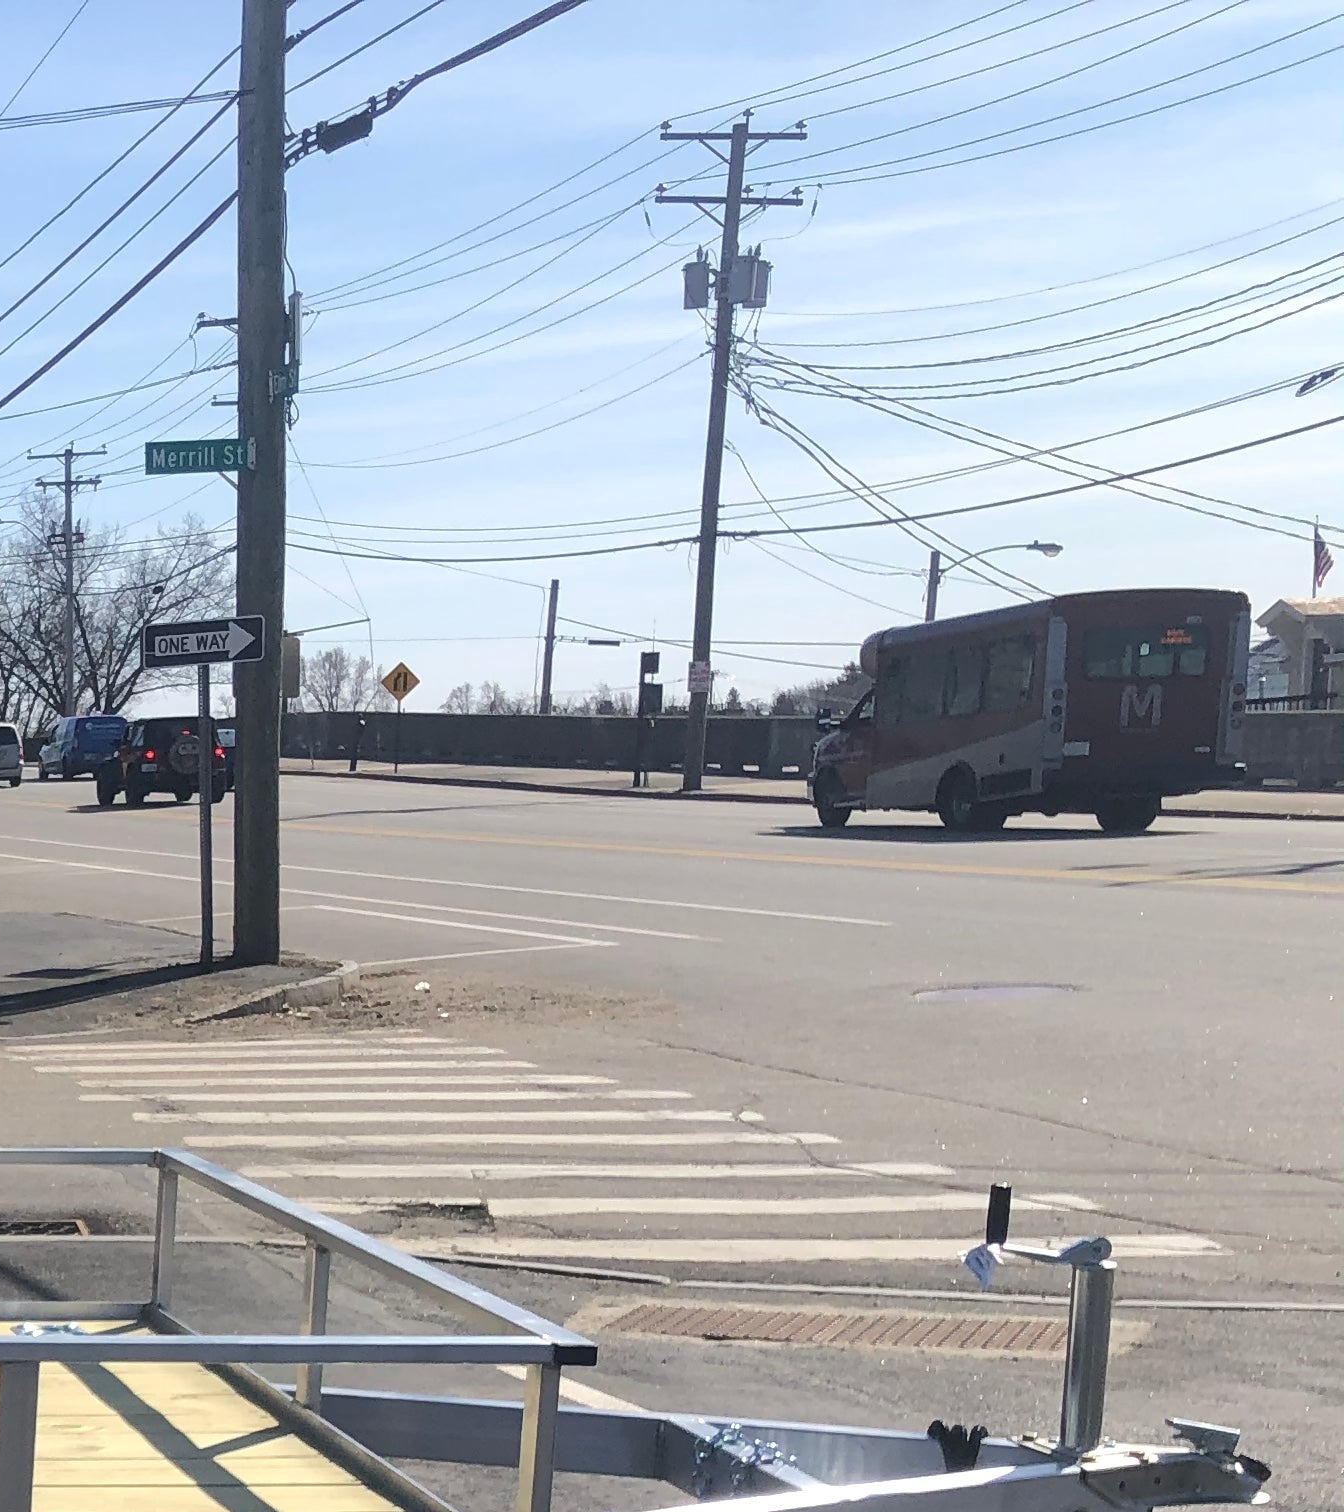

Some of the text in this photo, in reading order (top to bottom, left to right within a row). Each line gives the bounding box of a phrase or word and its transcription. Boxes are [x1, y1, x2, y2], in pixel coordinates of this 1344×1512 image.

[153, 445, 244, 468] Merrill St
[158, 633, 229, 653] ONE WAY
